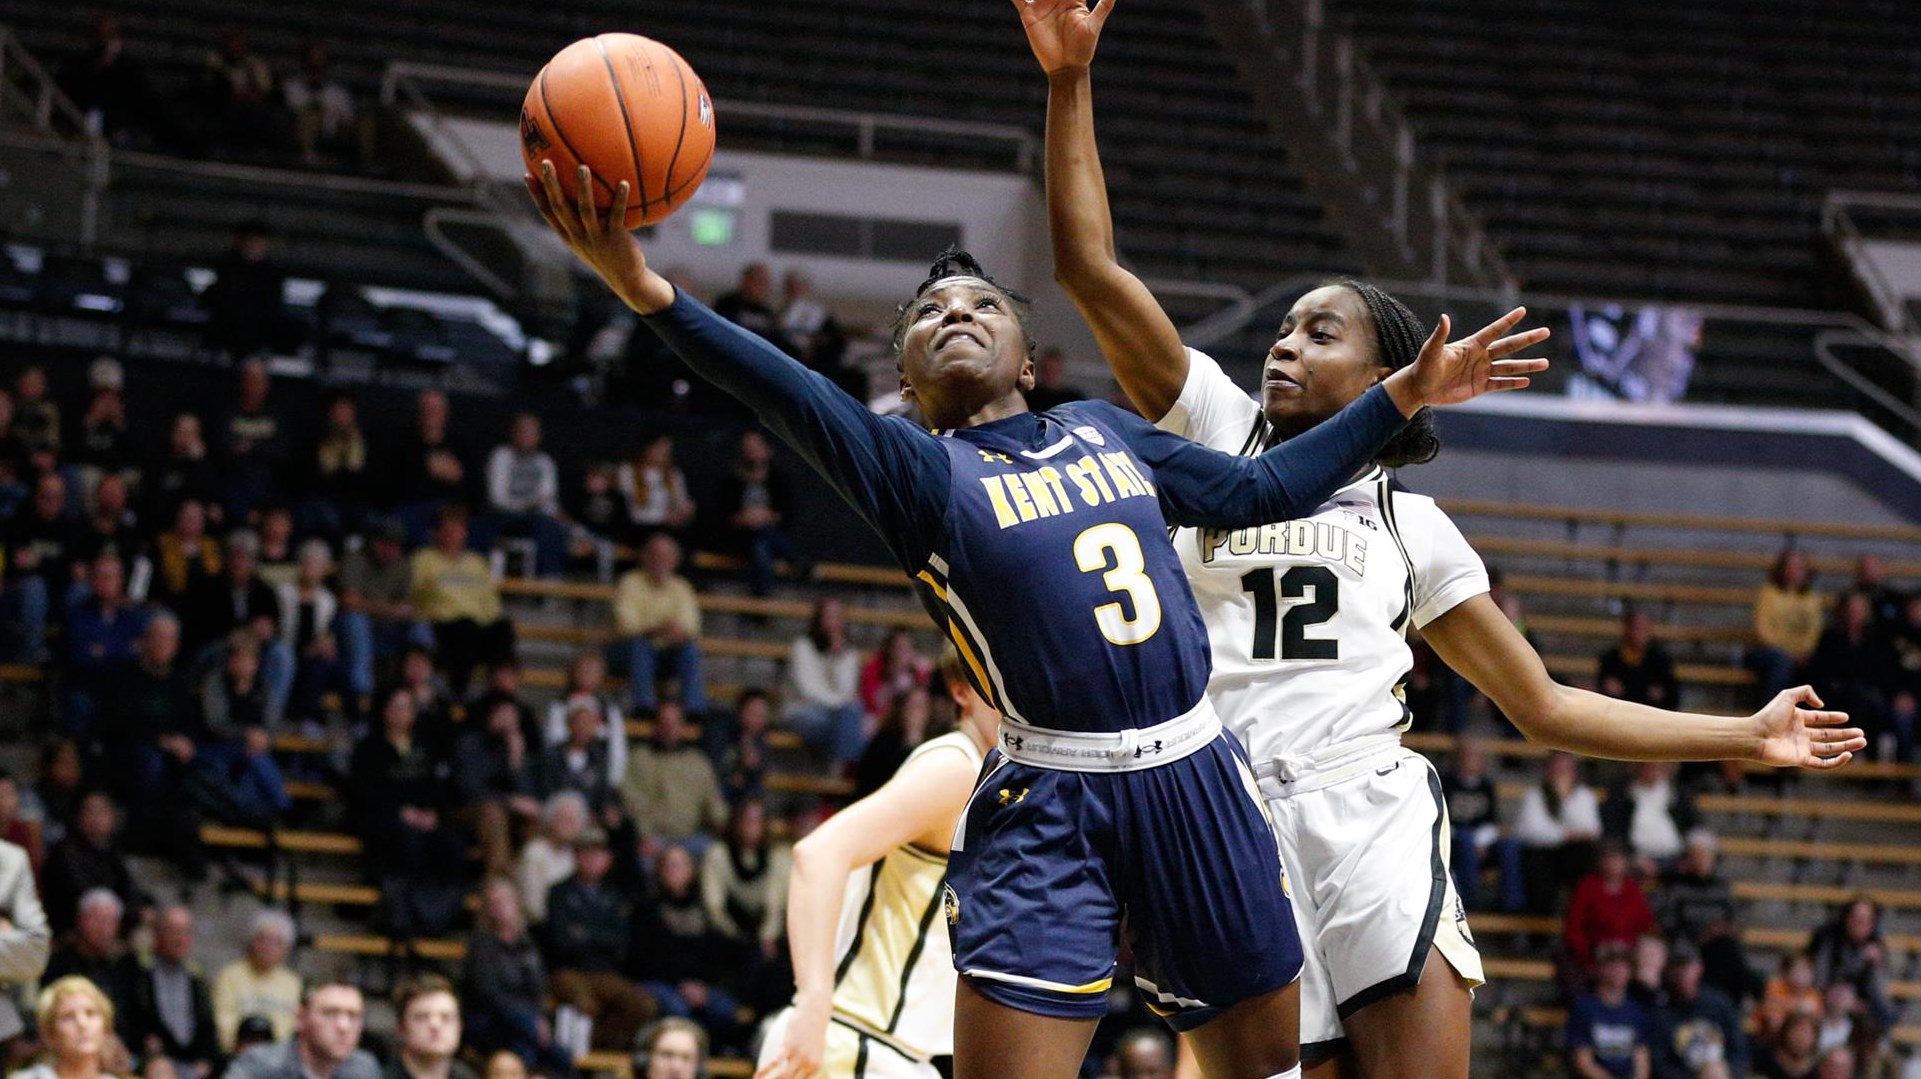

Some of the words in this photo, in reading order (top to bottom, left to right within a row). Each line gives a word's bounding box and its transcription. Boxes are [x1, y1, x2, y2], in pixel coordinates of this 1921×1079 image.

[979, 466, 1074, 529] KENT
[1073, 522, 1162, 646] 3
[1203, 520, 1368, 577] PURDUE
[1240, 565, 1339, 661] 12
